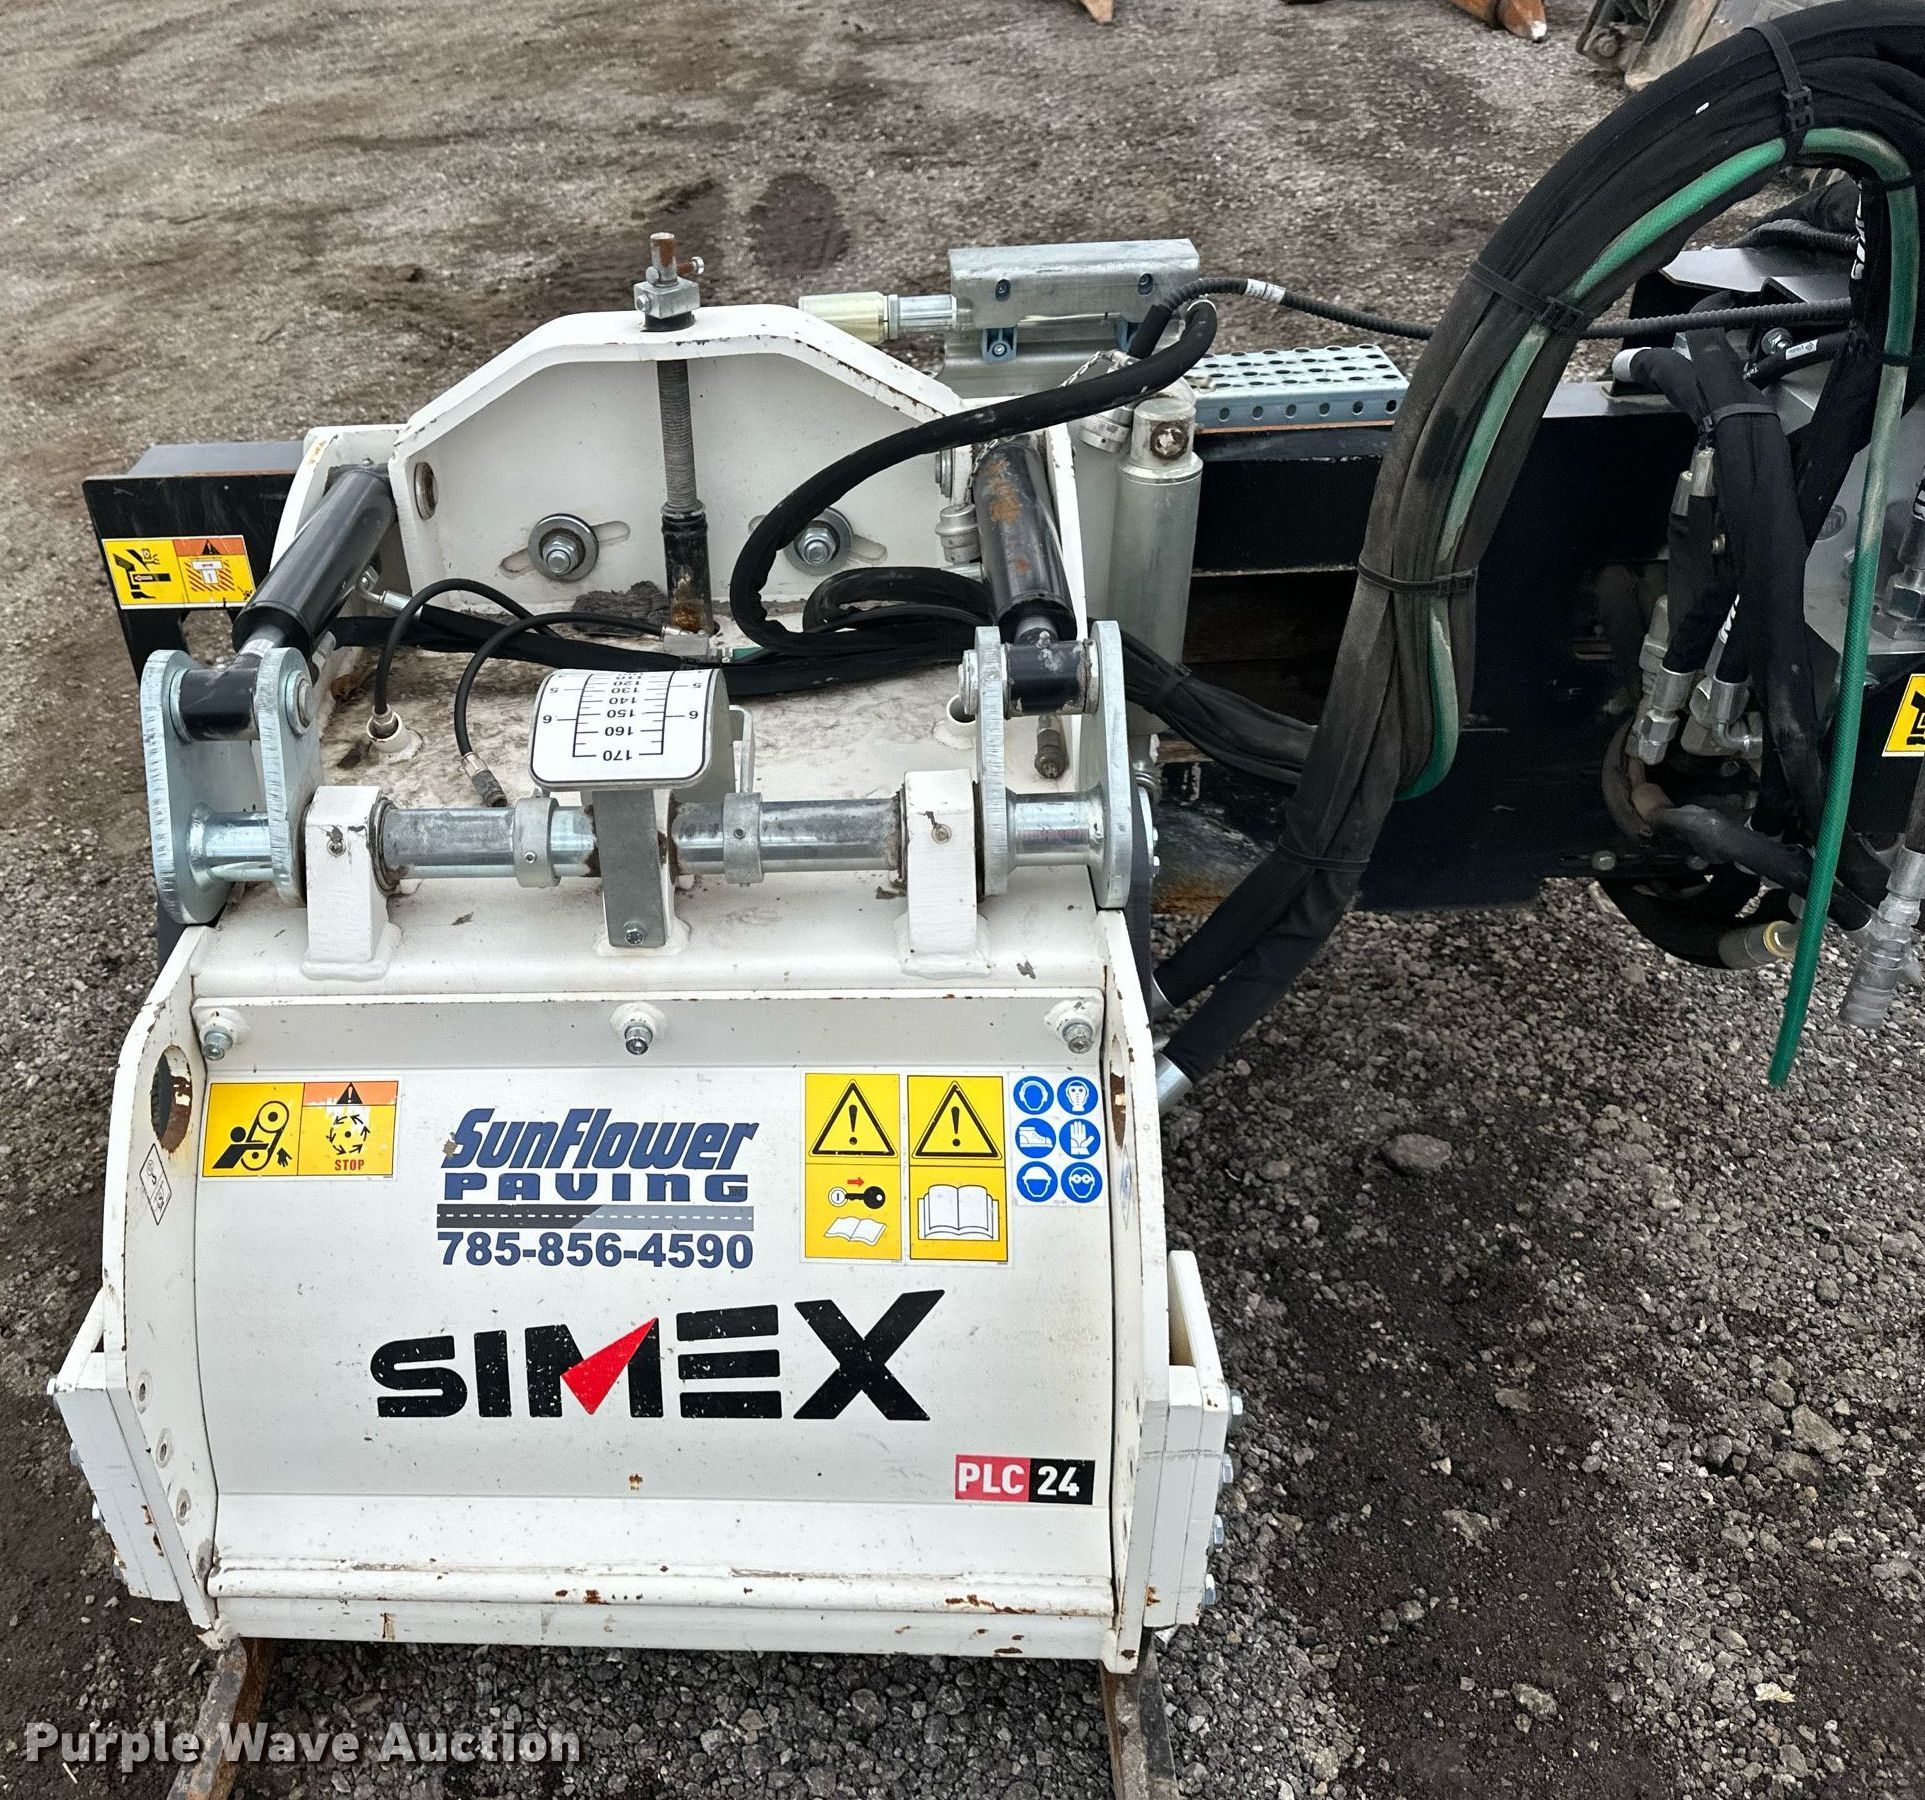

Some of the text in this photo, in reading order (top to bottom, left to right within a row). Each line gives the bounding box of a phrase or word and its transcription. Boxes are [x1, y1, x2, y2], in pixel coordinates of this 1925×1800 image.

[609, 697, 637, 705] 140
[542, 715, 552, 724] 6
[606, 709, 635, 718] 150
[689, 710, 699, 720] 6
[604, 726, 634, 737] 160
[602, 750, 633, 762] 170
[440, 1108, 760, 1170] SunFlower
[334, 1159, 365, 1171] STOP
[444, 1173, 748, 1203] PAVING
[437, 1231, 754, 1269] 785-856-4590
[370, 1289, 945, 1421] SIMEX
[958, 1462, 1080, 1497] PLC 24
